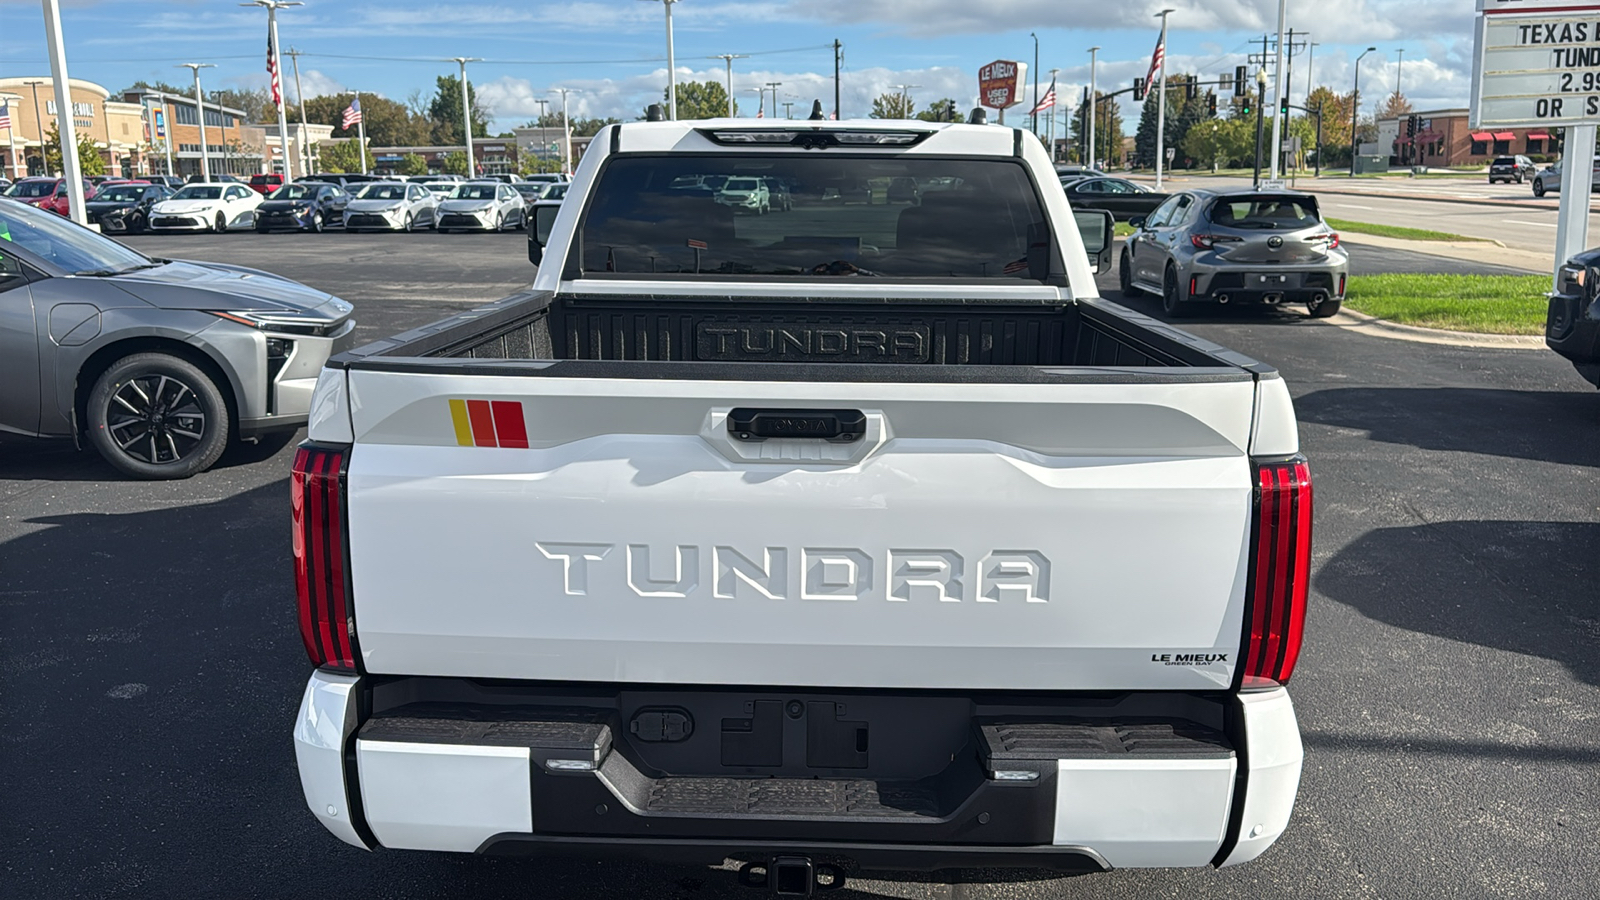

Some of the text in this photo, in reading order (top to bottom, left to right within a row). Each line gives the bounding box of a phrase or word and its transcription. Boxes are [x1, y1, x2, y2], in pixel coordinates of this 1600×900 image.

[1519, 22, 1588, 45] TEXAS
[981, 67, 990, 81] LE
[987, 88, 1009, 98] USED
[1536, 98, 1563, 118] OR
[704, 328, 924, 356] TUNDRA
[764, 418, 828, 432] TOYOTA
[534, 541, 1052, 603] TUNDRA
[1151, 653, 1228, 662] LE MIEUX
